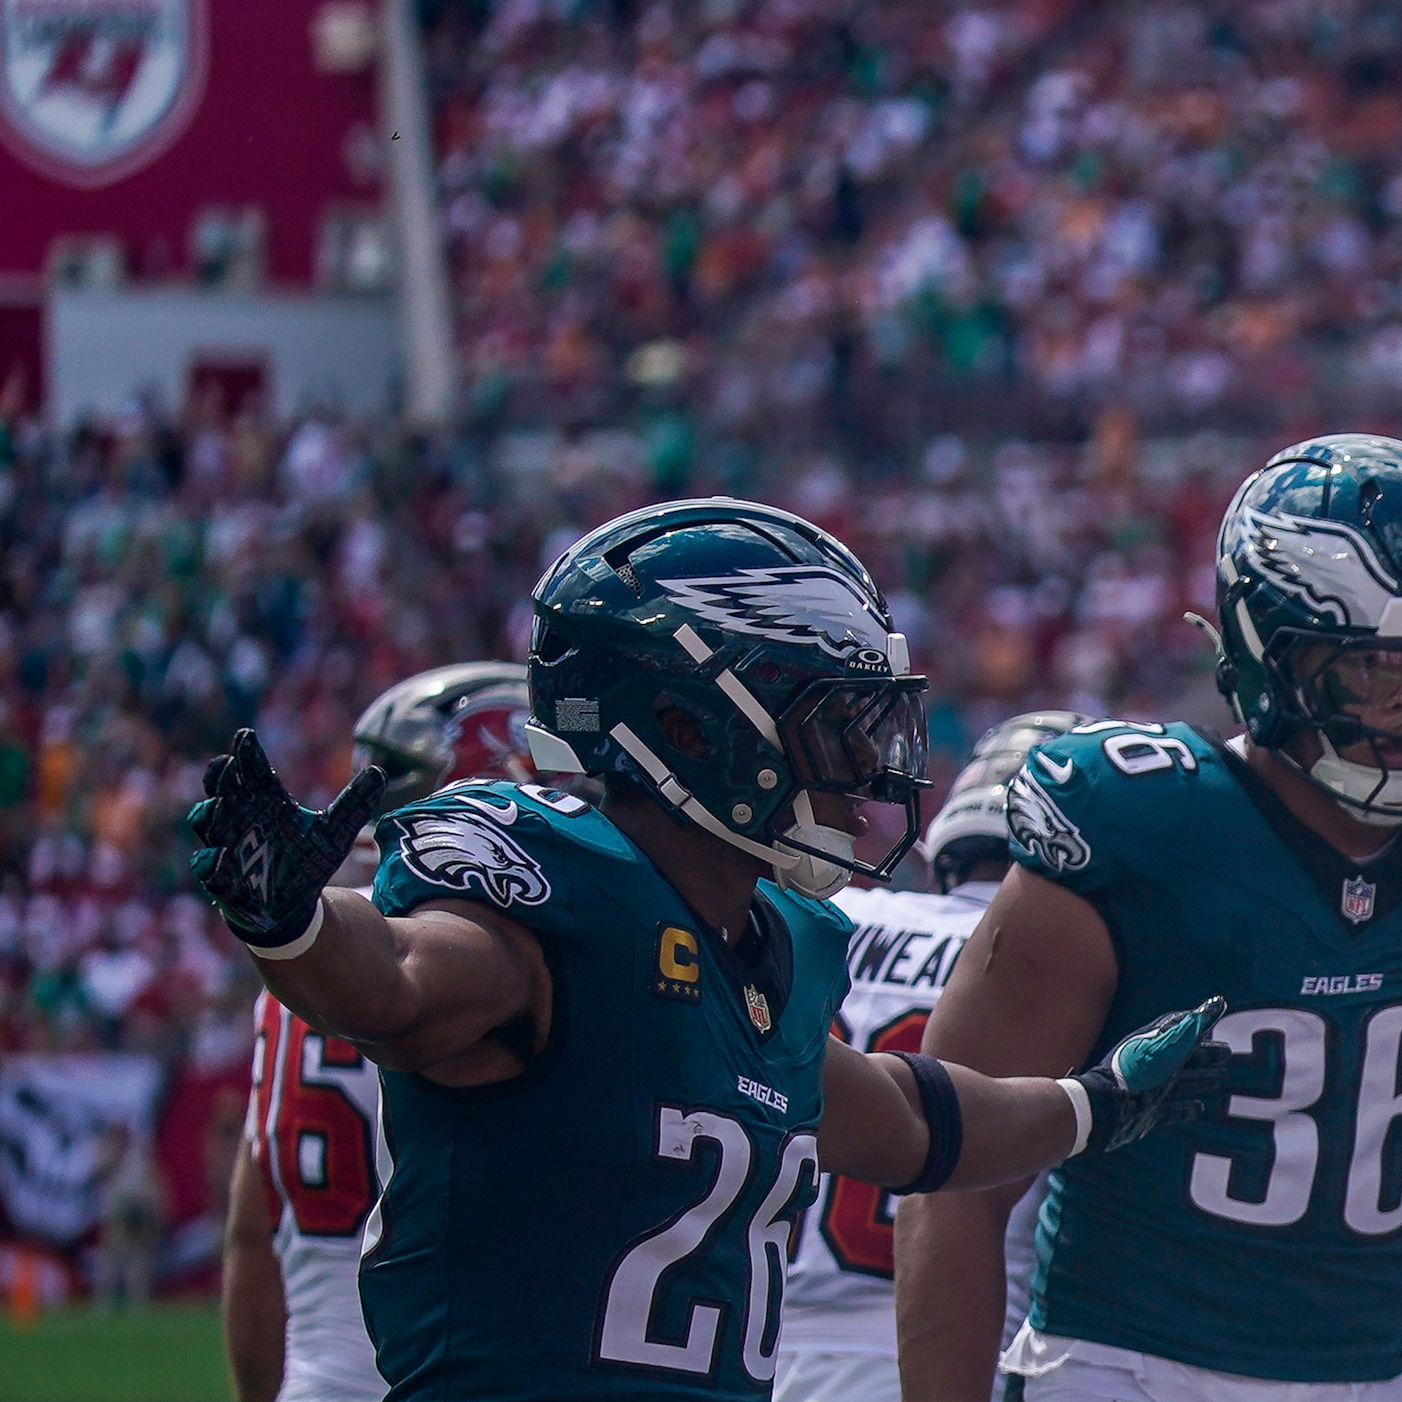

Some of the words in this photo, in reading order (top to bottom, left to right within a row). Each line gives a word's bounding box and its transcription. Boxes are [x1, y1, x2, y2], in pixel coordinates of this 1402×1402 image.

[849, 661, 889, 673] OAKLEY
[659, 927, 700, 983] C
[848, 924, 968, 988] WEA
[1301, 973, 1385, 996] EAGLES
[736, 1074, 789, 1115] EAGLES
[599, 1106, 819, 1382] 26
